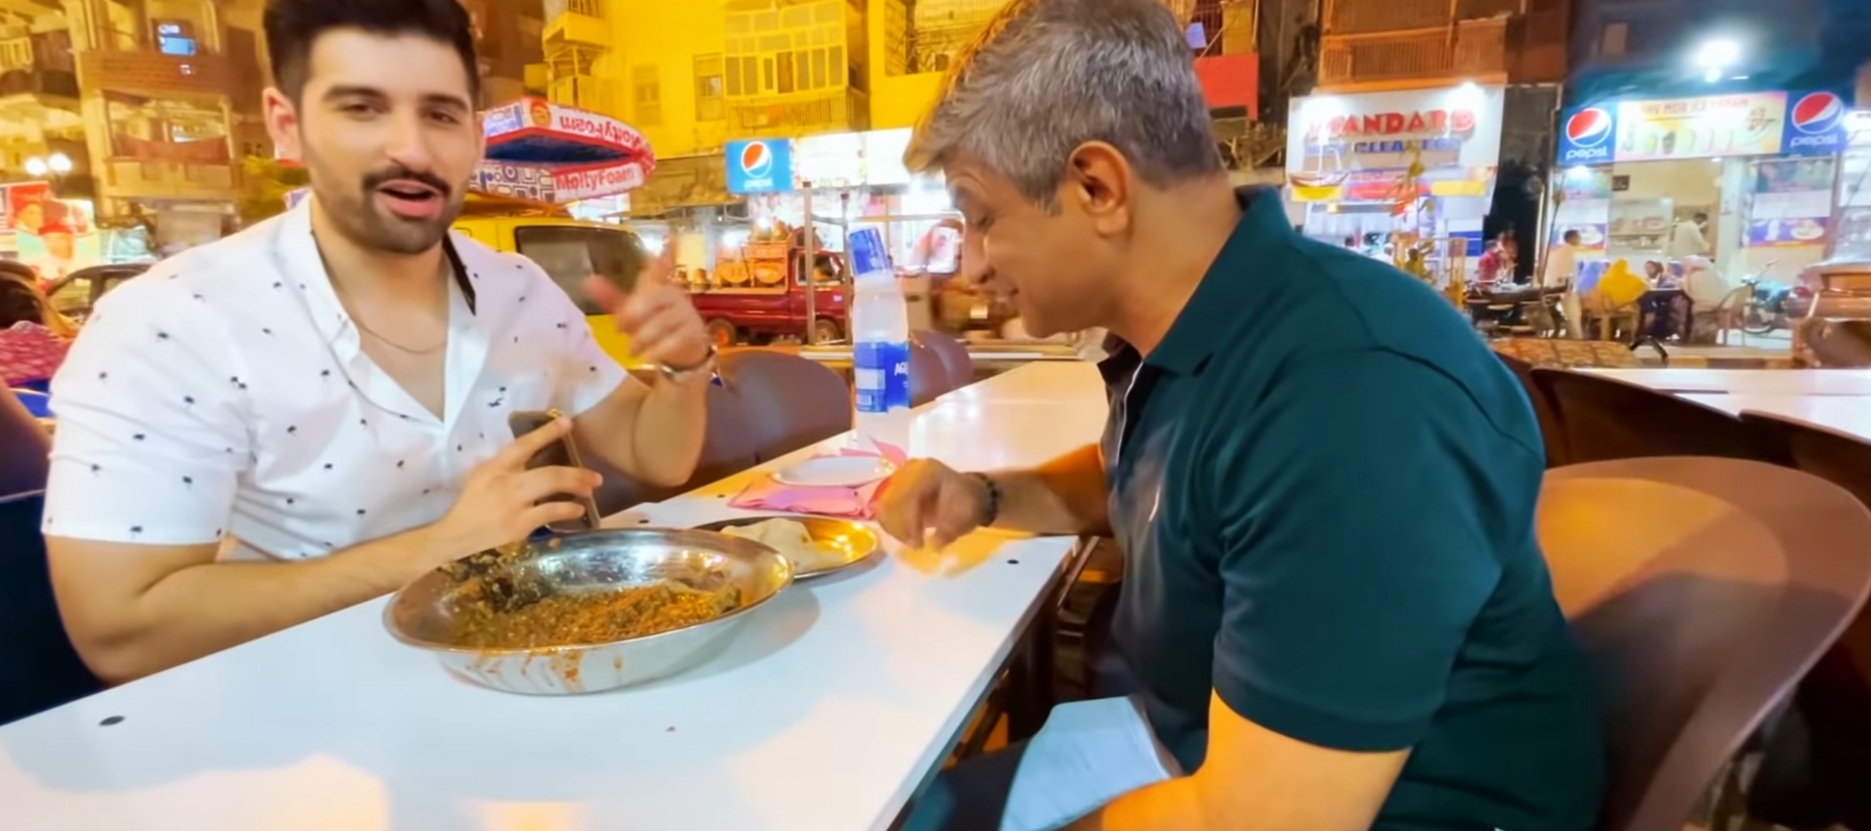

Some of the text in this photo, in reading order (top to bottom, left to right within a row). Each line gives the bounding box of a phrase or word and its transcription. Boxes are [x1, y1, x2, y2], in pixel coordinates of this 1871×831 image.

[1789, 134, 1838, 148] pepsi
[1566, 145, 1608, 160] pepsi
[556, 166, 634, 190] MoltyFoam
